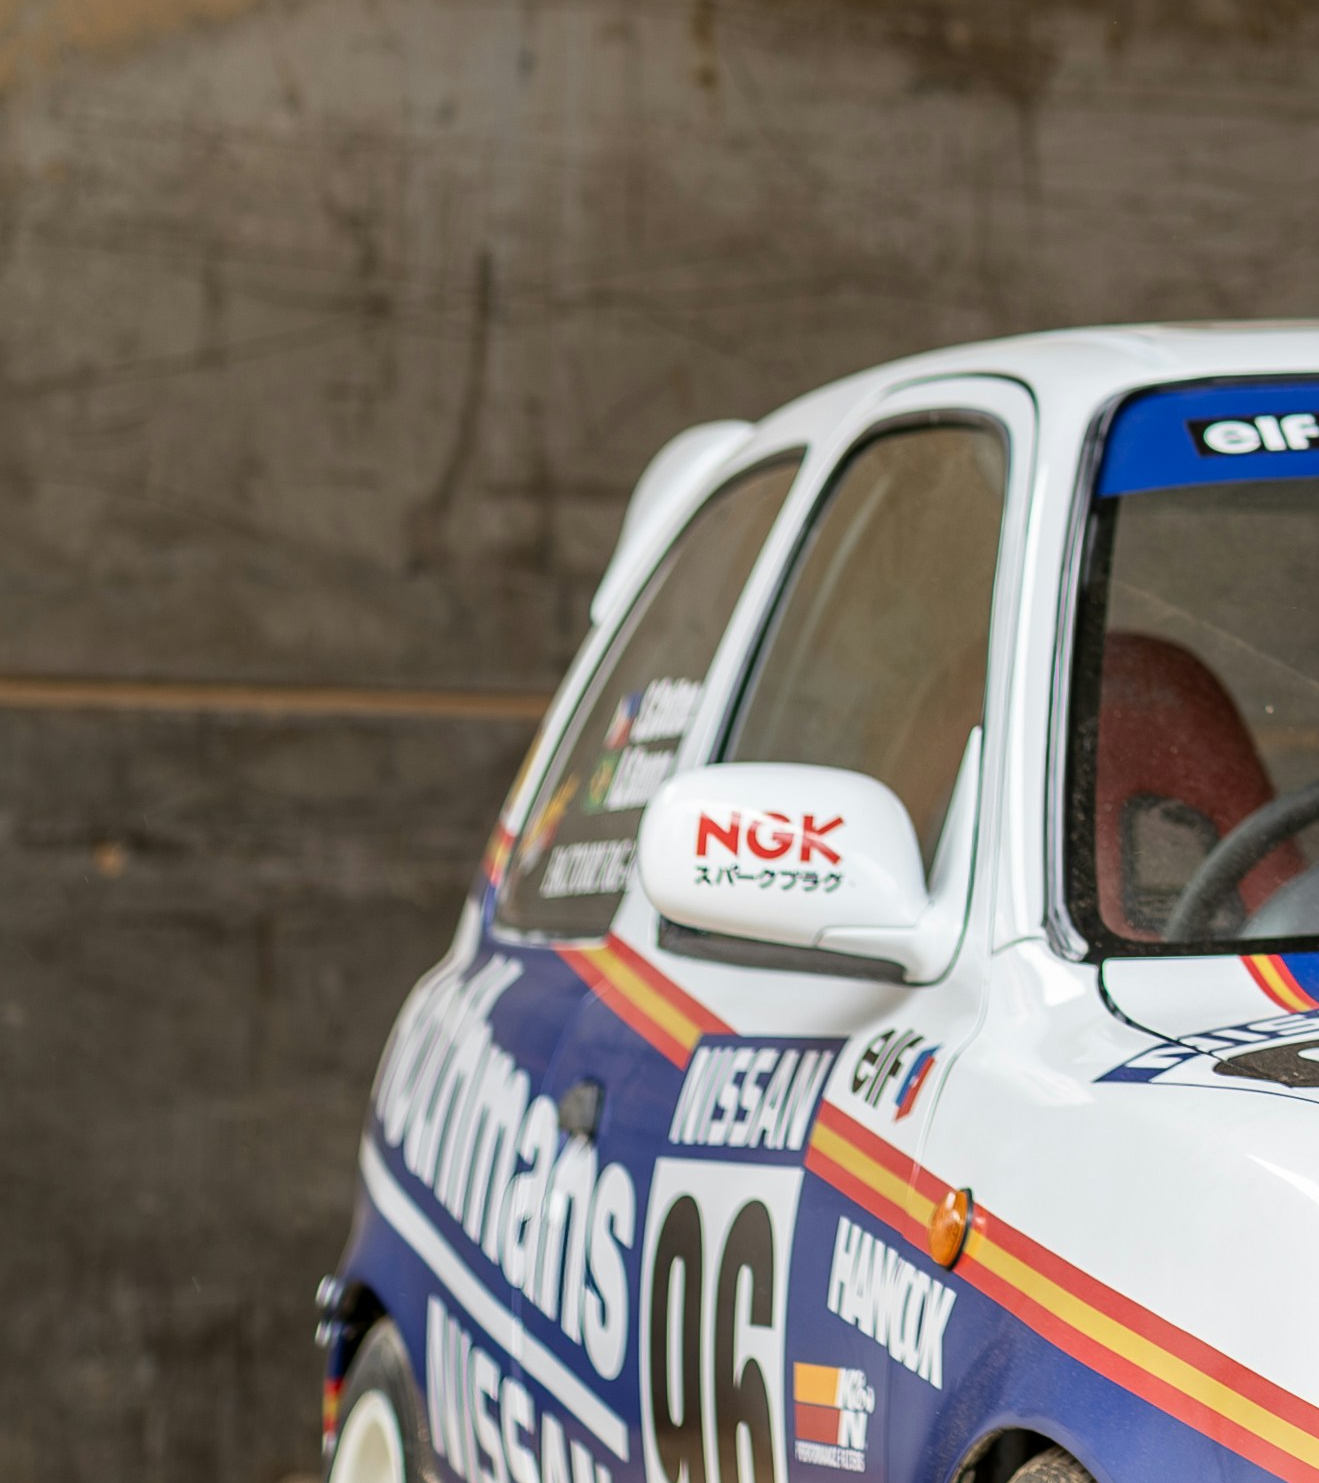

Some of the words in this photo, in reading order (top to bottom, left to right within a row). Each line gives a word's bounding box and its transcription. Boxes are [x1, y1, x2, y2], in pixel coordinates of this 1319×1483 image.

[694, 811, 844, 865] NGK
[694, 865, 843, 894] スパークプラグ
[669, 1046, 835, 1151] NISSAN
